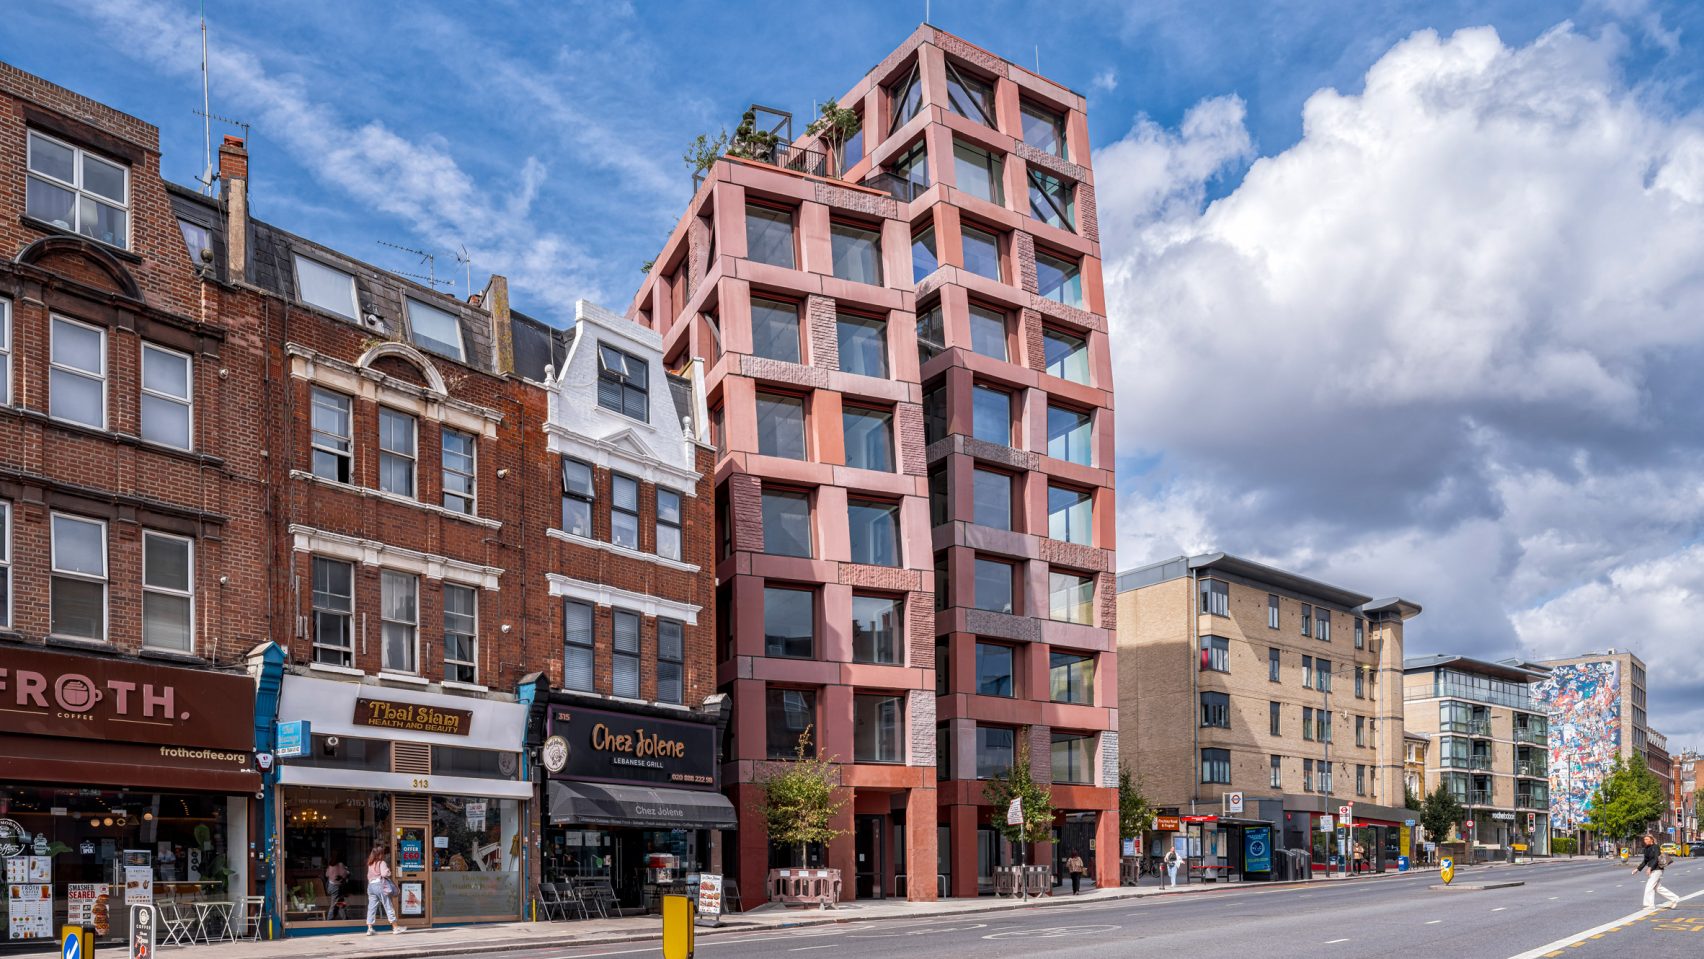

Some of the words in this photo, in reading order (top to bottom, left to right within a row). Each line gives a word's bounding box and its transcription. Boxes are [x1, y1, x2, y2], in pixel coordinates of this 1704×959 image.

[57, 712, 94, 721] COFFEE
[369, 701, 413, 721] Thai
[416, 707, 459, 727] Siam
[558, 712, 571, 721] 315
[368, 718, 404, 728] HEALTH
[405, 722, 423, 730] AND
[425, 724, 458, 733] BEAUTY
[592, 723, 633, 752] Chez
[635, 728, 685, 758] Jolene
[160, 746, 246, 764] frothcoffee.org
[613, 757, 645, 767] LEBANESE
[646, 761, 664, 769] GRILL
[413, 779, 429, 788] 313
[635, 805, 657, 816] Chez
[657, 807, 684, 817] Jolene
[69, 890, 97, 899] SEARED.
